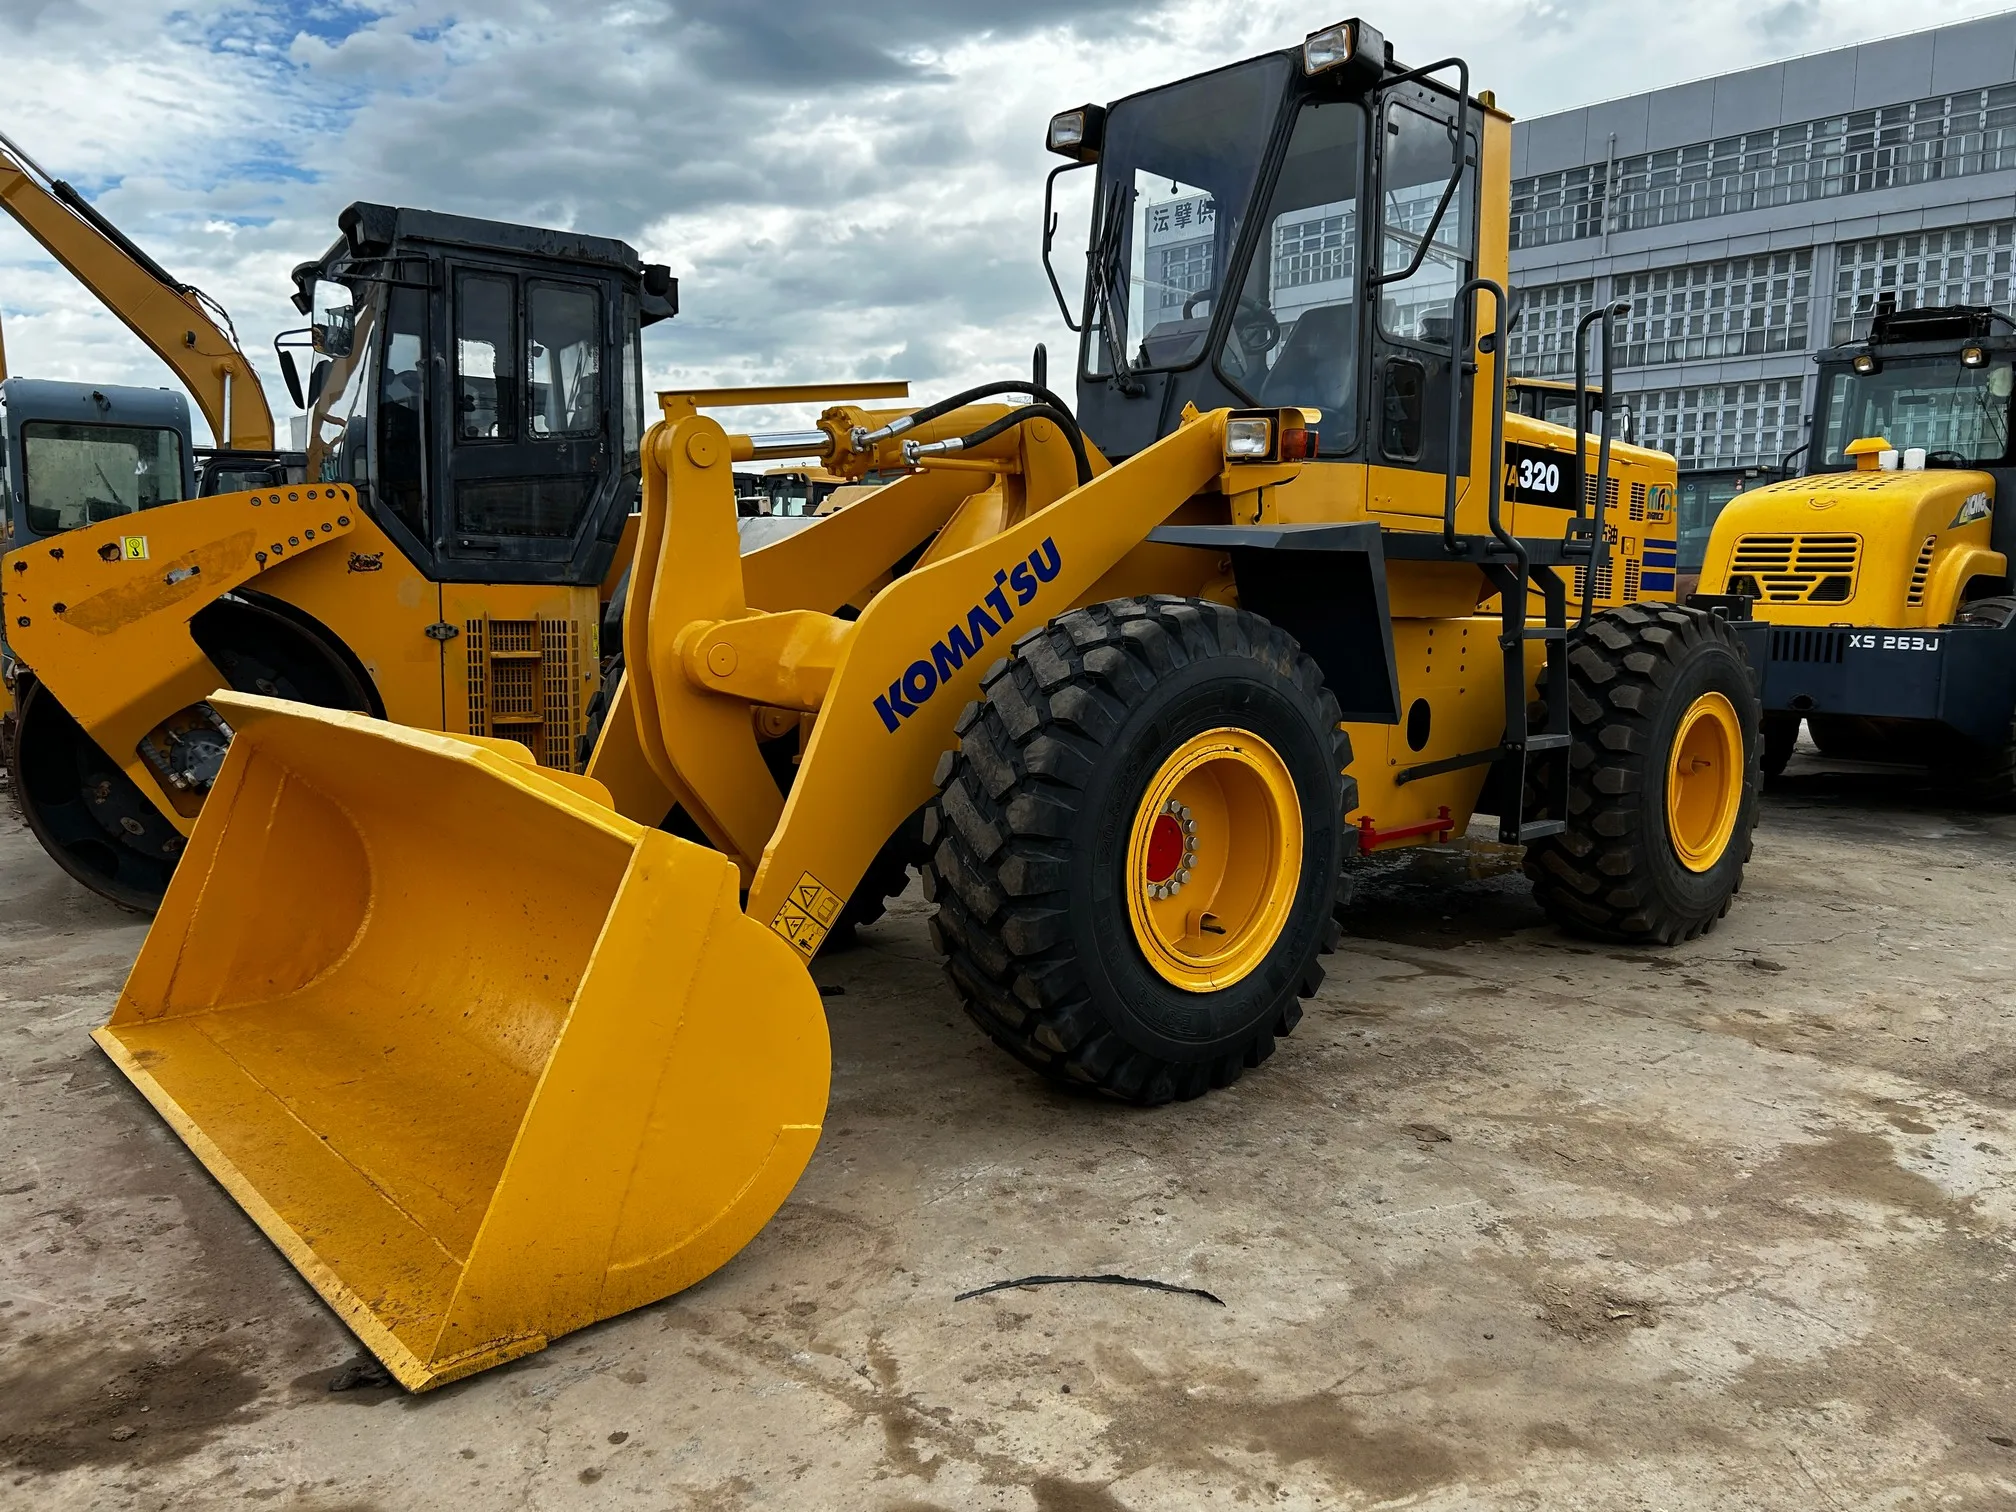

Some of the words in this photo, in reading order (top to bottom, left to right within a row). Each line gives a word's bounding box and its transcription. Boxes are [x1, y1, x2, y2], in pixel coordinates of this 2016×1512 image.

[1504, 459, 1559, 493] A320
[873, 536, 1062, 734] KOMATSU
[1848, 634, 1876, 649] XS
[1883, 636, 1939, 651] 263J
